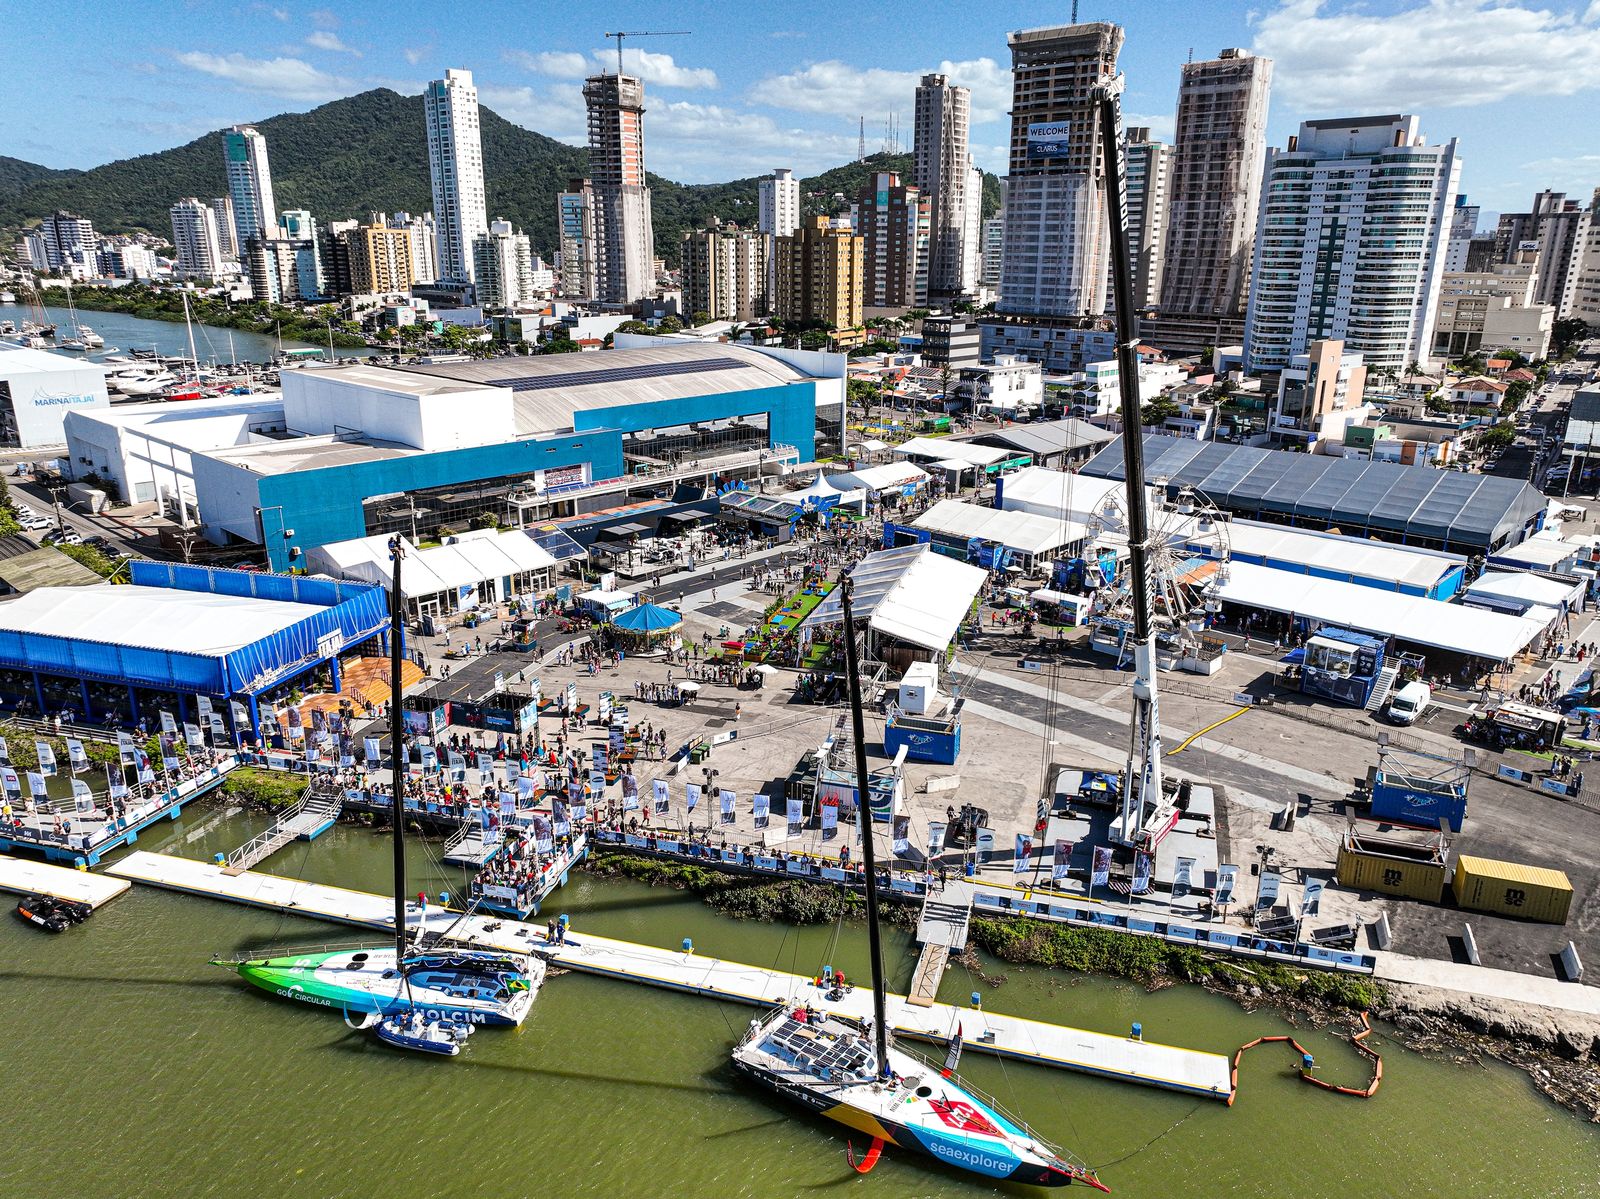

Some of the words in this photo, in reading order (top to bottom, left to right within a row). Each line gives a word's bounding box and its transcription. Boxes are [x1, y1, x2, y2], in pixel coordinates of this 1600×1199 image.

[1031, 126, 1068, 136] WELCOME
[1036, 145, 1058, 153] CLARUS
[276, 988, 288, 997] GO
[294, 993, 331, 1006] CIRCULAR
[413, 1008, 486, 1023] HOLCIM
[930, 1142, 1013, 1172] seaexplorer
